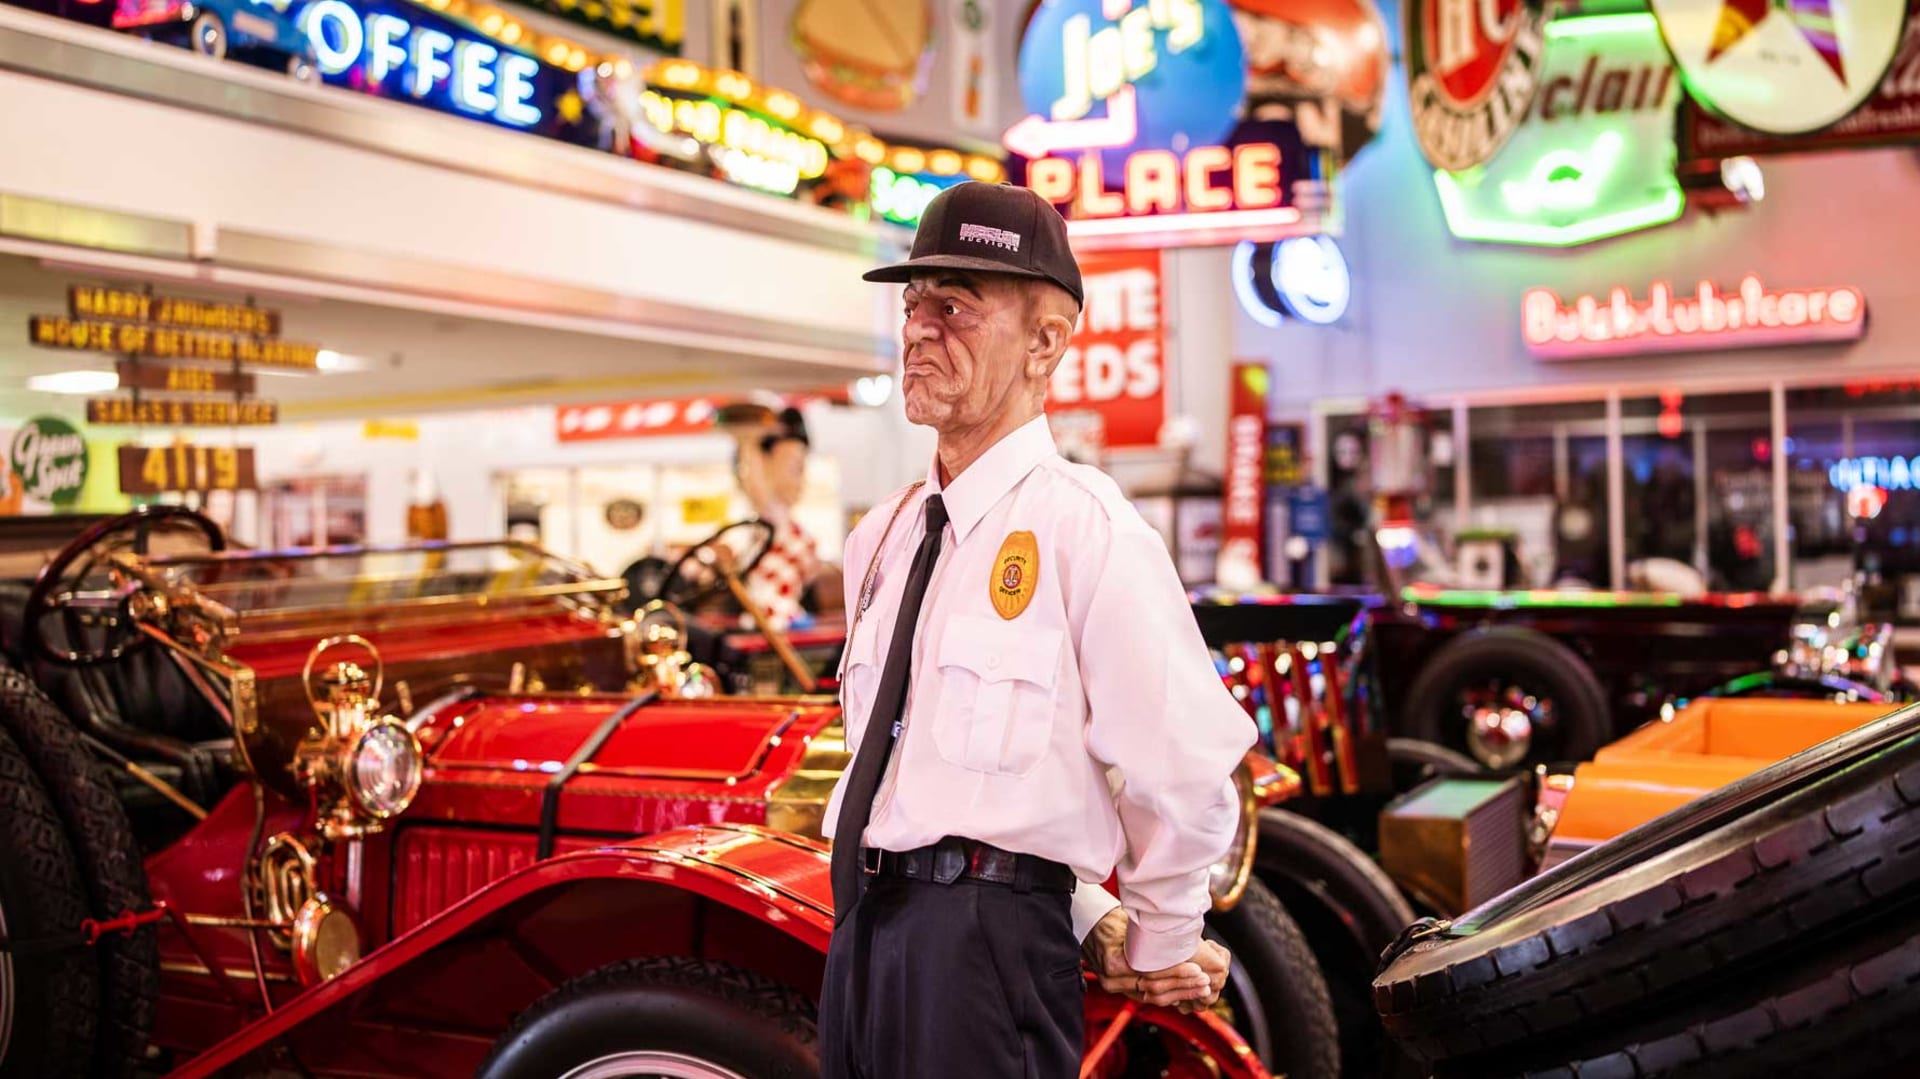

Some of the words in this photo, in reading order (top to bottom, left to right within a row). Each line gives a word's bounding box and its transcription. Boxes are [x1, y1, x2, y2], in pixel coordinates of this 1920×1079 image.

[262, 0, 543, 126] OFFEE
[1026, 143, 1284, 217] PLACE
[38, 320, 113, 349] HOUSE
[118, 323, 148, 352] OF
[1051, 337, 1160, 403] EDS
